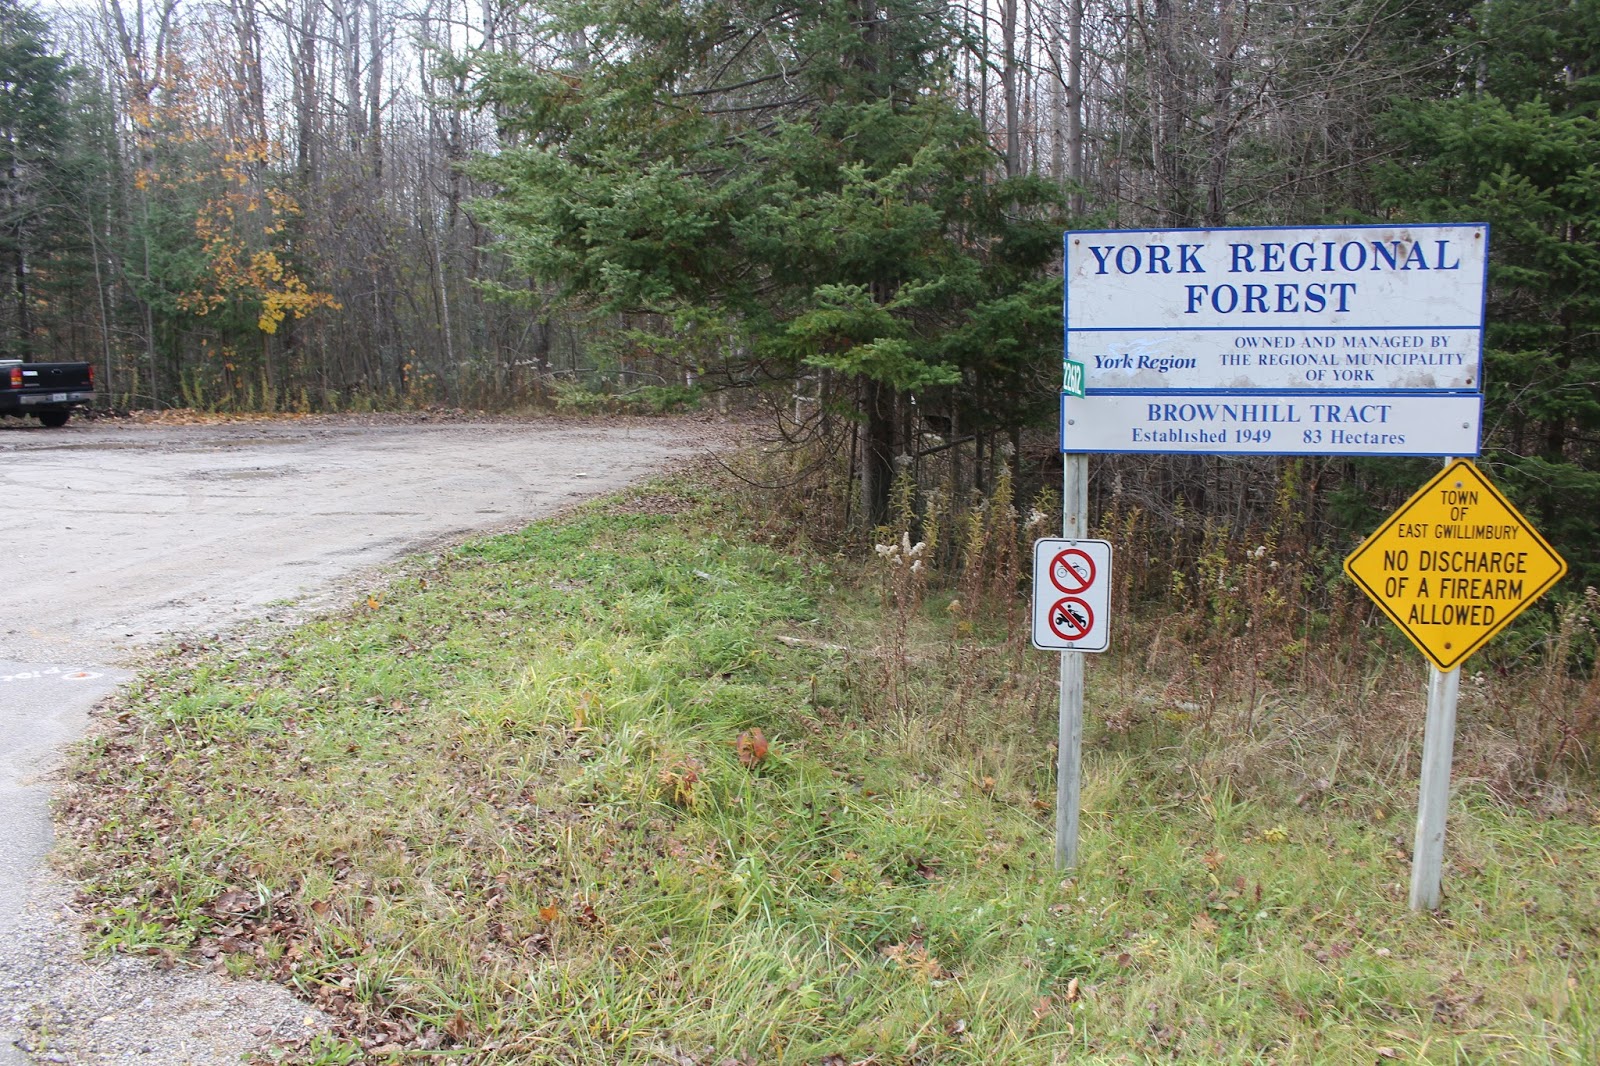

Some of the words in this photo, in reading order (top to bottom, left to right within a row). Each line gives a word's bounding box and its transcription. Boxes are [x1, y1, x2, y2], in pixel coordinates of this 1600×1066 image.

[1088, 244, 1206, 275] YORK
[1227, 240, 1460, 272] REGIONAL
[1184, 283, 1357, 314] FOREST
[1234, 336, 1296, 349] OWNED
[1300, 335, 1336, 348] AND
[1342, 335, 1424, 348] MANAGED
[1431, 335, 1451, 348] BY
[1094, 353, 1134, 369] York
[1137, 354, 1197, 373] Region
[1219, 353, 1251, 366] THE
[1258, 353, 1339, 366] REGIONAL
[1345, 353, 1466, 366] MUNICIPALITY
[1305, 369, 1326, 381] OF
[1332, 369, 1375, 381] YORK
[1146, 403, 1301, 423] BROWNHILL
[1309, 404, 1392, 423] TRACT
[1132, 427, 1227, 443] Established
[1235, 428, 1272, 444] 1949
[1303, 429, 1322, 444] 83
[1330, 429, 1406, 445] Hectares
[1440, 490, 1478, 505] TOWN
[1450, 507, 1469, 521] OF
[1398, 523, 1429, 538] EAST
[1434, 525, 1519, 540] GWILLIMBURY
[1383, 550, 1408, 571] NO
[1419, 551, 1528, 573] DISCHARGE
[1385, 576, 1409, 598] OF
[1417, 577, 1429, 598] A
[1439, 578, 1523, 600] FIREARM
[1407, 604, 1495, 626] ALLOWED
